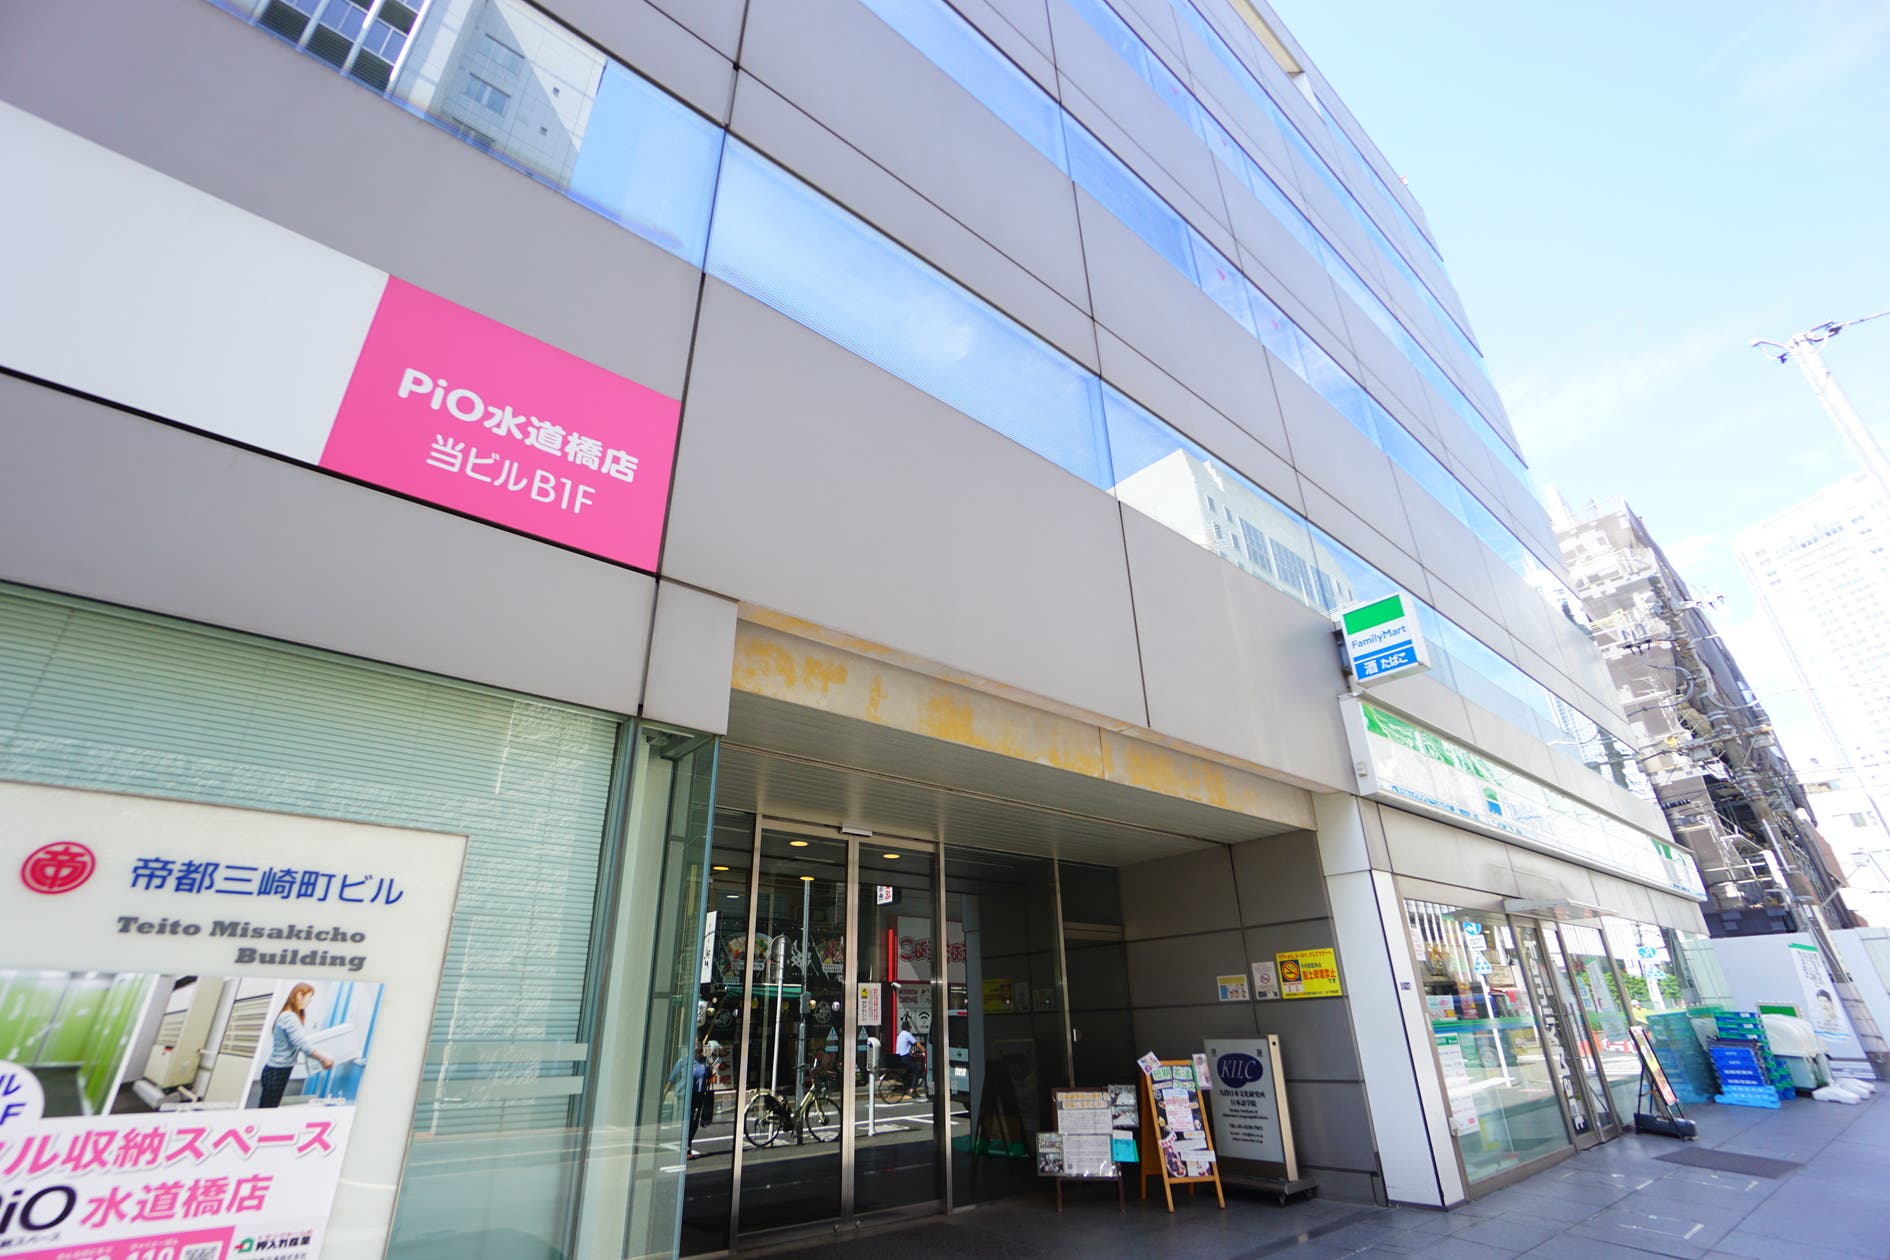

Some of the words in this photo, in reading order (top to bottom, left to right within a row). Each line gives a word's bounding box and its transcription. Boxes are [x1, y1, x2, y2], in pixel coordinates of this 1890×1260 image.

[397, 367, 639, 483] PiO水道橋店
[426, 433, 596, 514] 当ビルB1F
[1351, 625, 1407, 649] FamilyMart
[1363, 659, 1379, 676] 酒
[1380, 652, 1409, 670] たばこ
[130, 856, 404, 906] 帝都三崎町ビル
[117, 915, 201, 937] Teito
[209, 920, 366, 944] Misakicho
[234, 947, 367, 971] Building
[1221, 1060, 1257, 1080] KILC
[79, 1174, 273, 1229] 水道橋店
